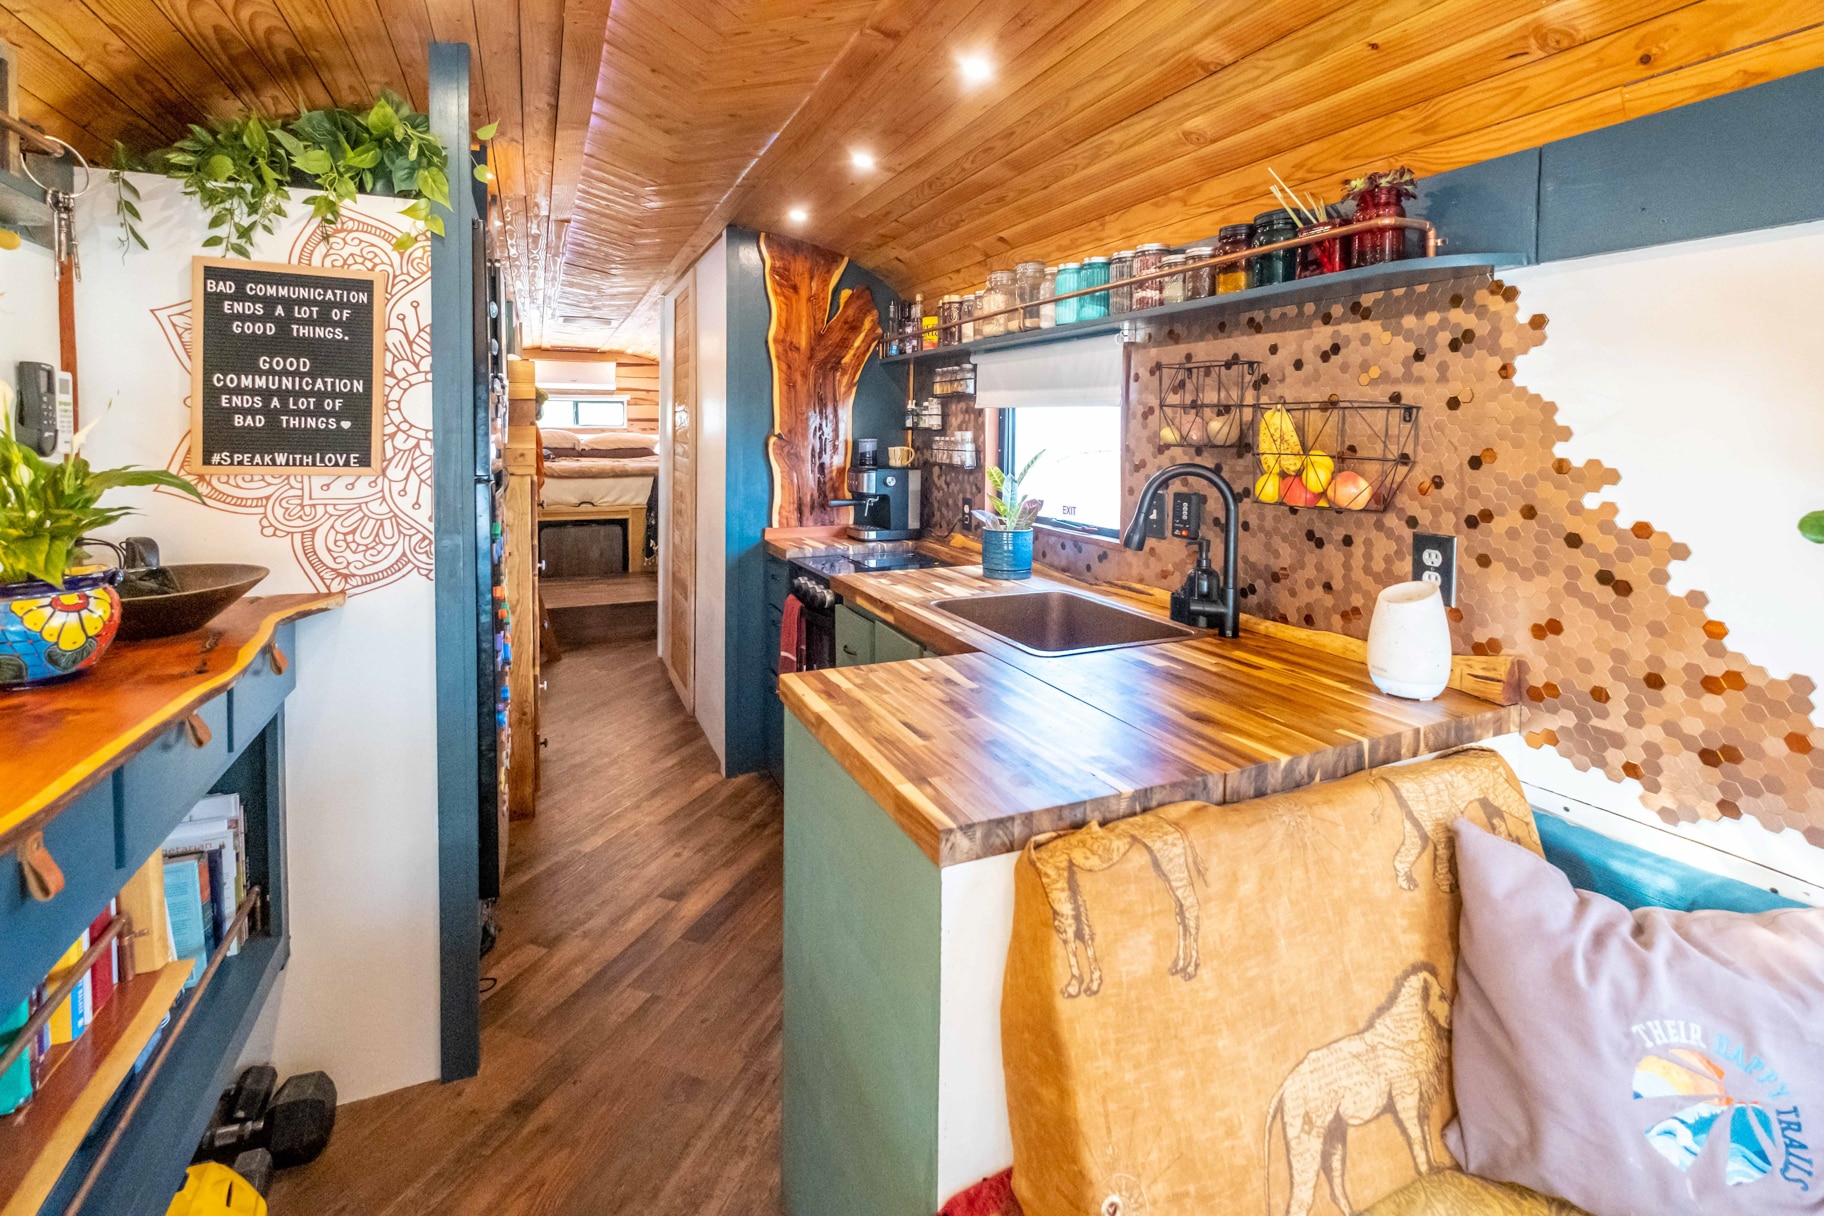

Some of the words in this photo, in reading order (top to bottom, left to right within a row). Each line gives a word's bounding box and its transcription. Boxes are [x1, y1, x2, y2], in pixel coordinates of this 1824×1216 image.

[206, 279, 235, 294] BAD
[246, 283, 368, 304] COMMUNICATION
[224, 301, 264, 316] ENDS
[275, 305, 285, 317] A
[294, 306, 319, 319] LOT
[332, 309, 351, 321] OF
[232, 322, 276, 335] GOOD
[291, 325, 349, 341] THINGS.
[259, 356, 310, 371] GOOD
[213, 373, 363, 393] COMMUNICATION
[221, 395, 263, 409] ENDS
[270, 397, 280, 409] A
[289, 397, 316, 410] LOT
[324, 399, 343, 411] OF
[234, 415, 265, 428] BAD
[280, 416, 337, 429] THINGS
[1062, 505, 1077, 516] EXIT
[1631, 1020, 1707, 1048] THEIR
[1713, 1033, 1790, 1099] HAPPY
[1776, 1105, 1813, 1191] TRAILS
